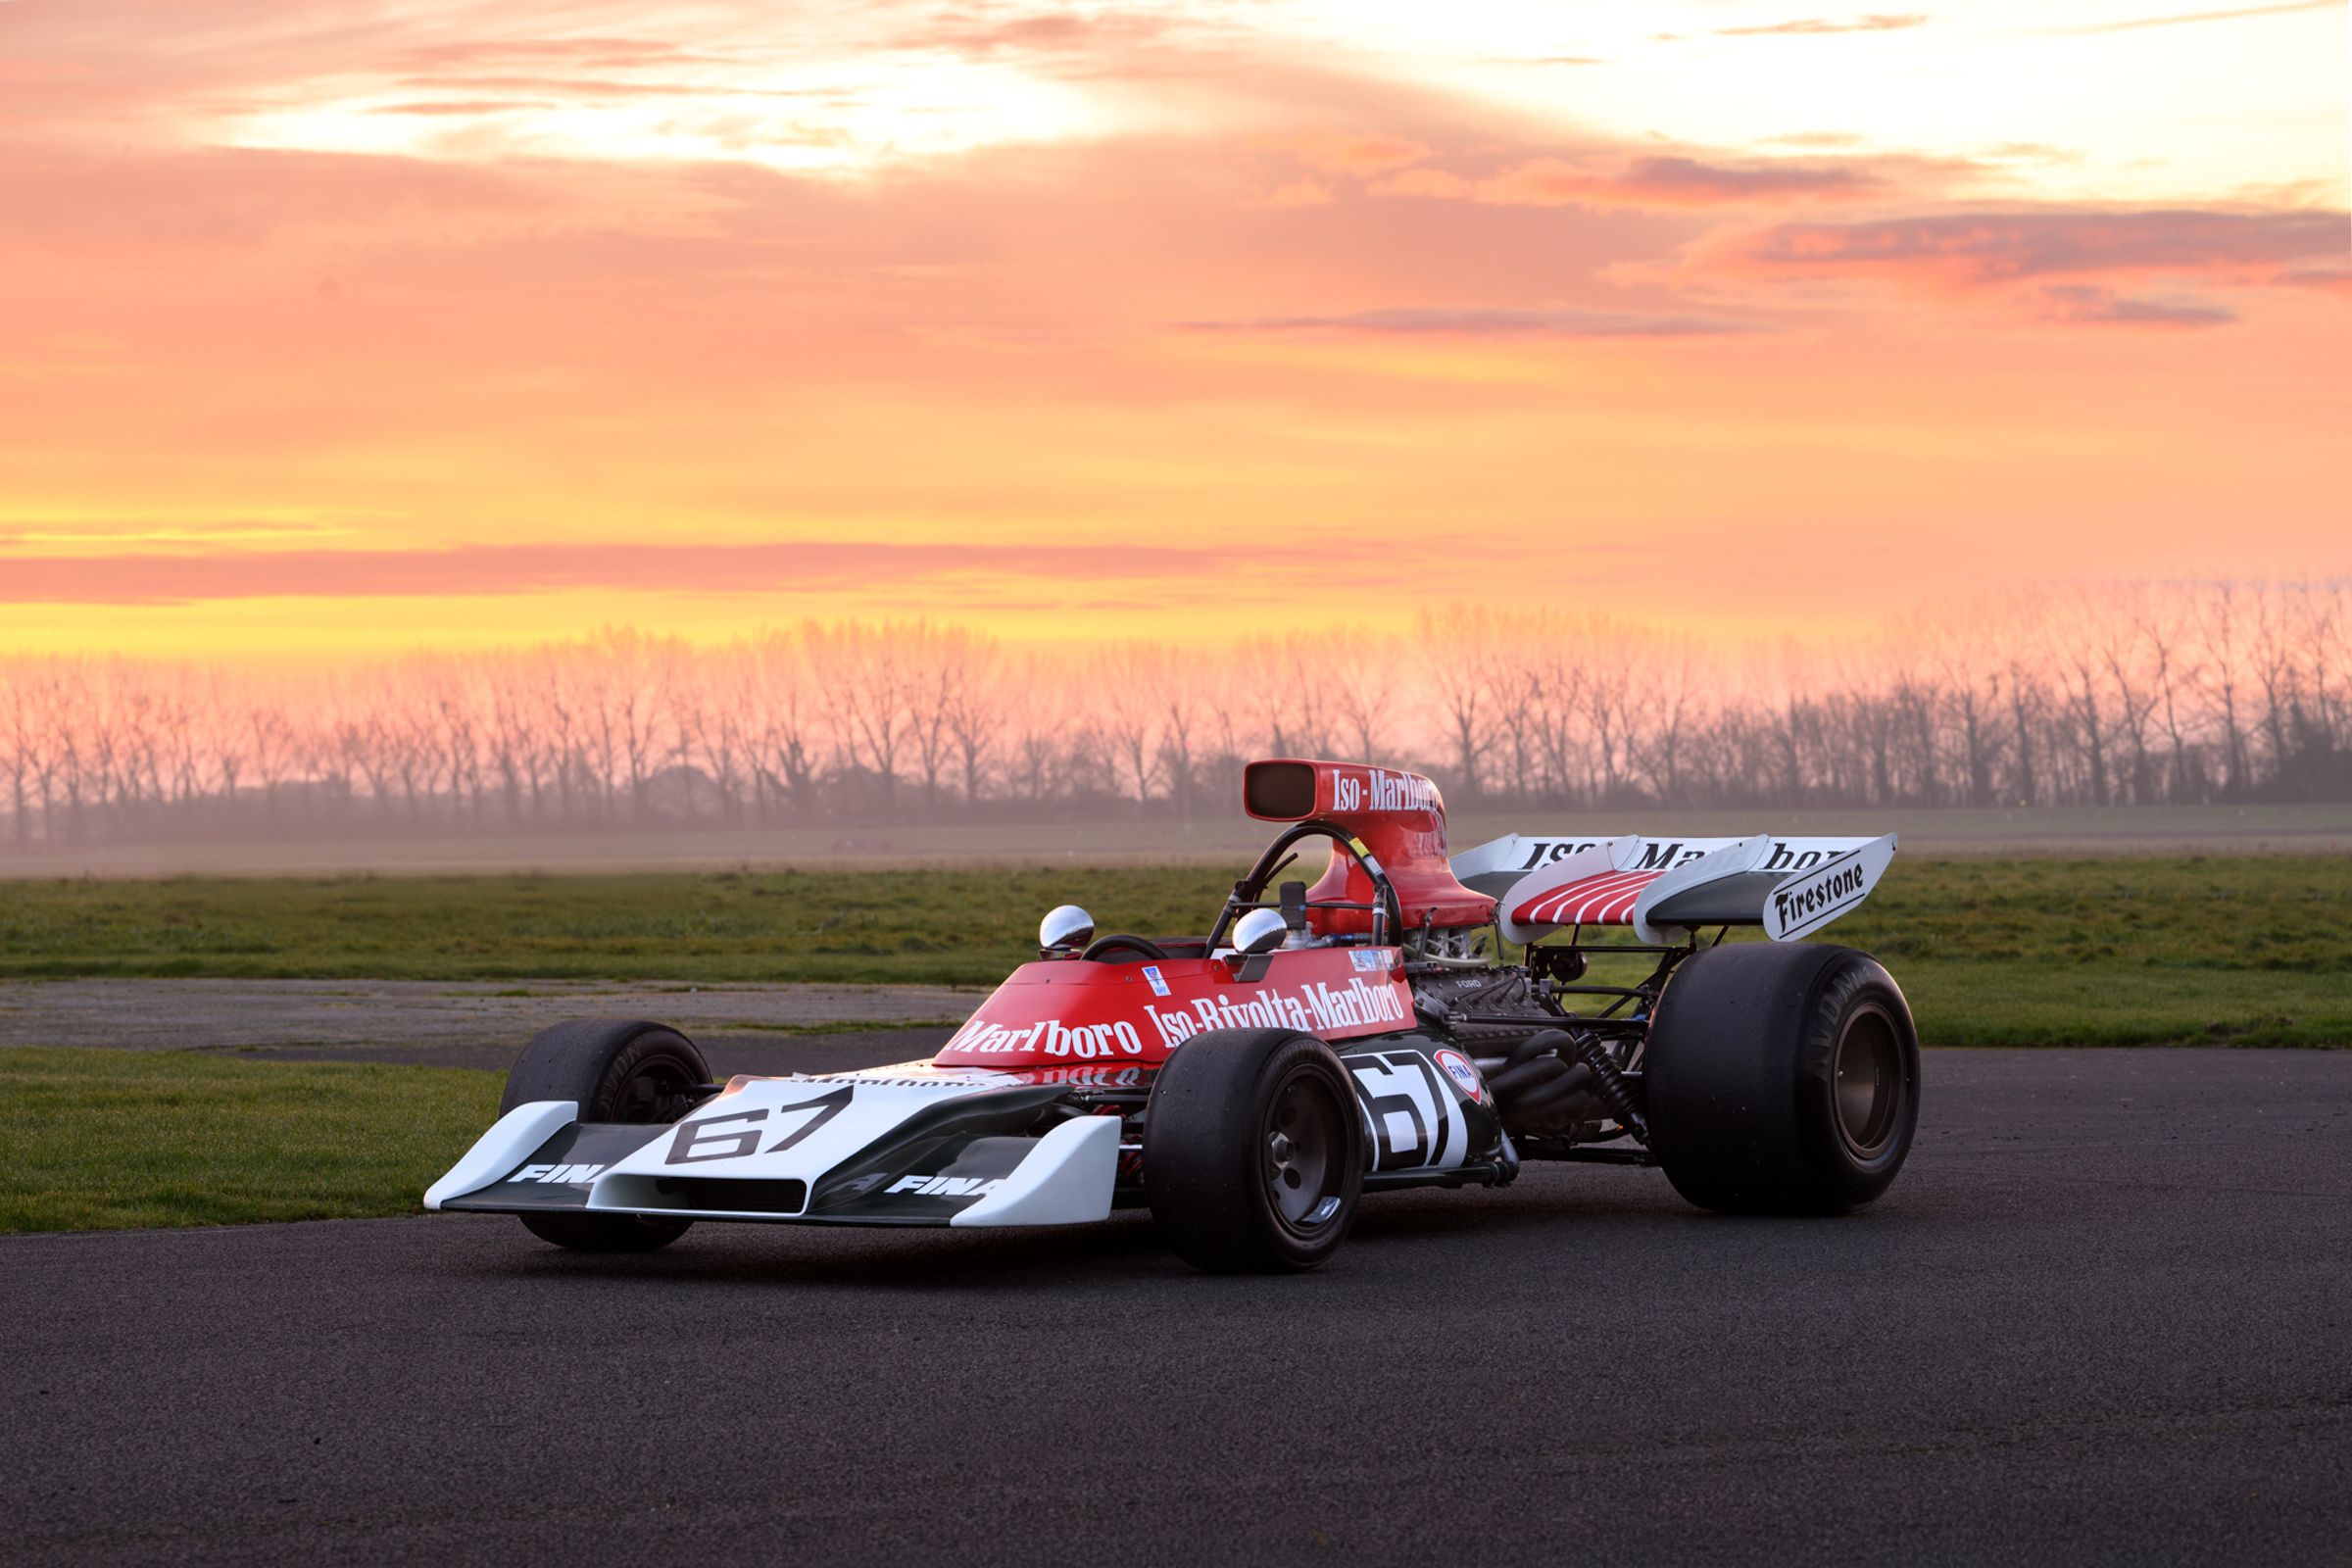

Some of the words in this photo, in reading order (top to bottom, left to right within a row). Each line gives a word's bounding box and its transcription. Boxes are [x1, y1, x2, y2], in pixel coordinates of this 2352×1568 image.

[1518, 843, 1596, 869] IS
[1775, 862, 1864, 933] Firestone
[1455, 979, 1482, 989] FORD
[944, 1020, 1143, 1059] Marlboro
[1448, 1064, 1472, 1079] FINA
[1340, 1052, 1449, 1171] 67
[664, 1085, 855, 1165] 67
[507, 1164, 606, 1184] FIN
[884, 1175, 1007, 1197] FINA
